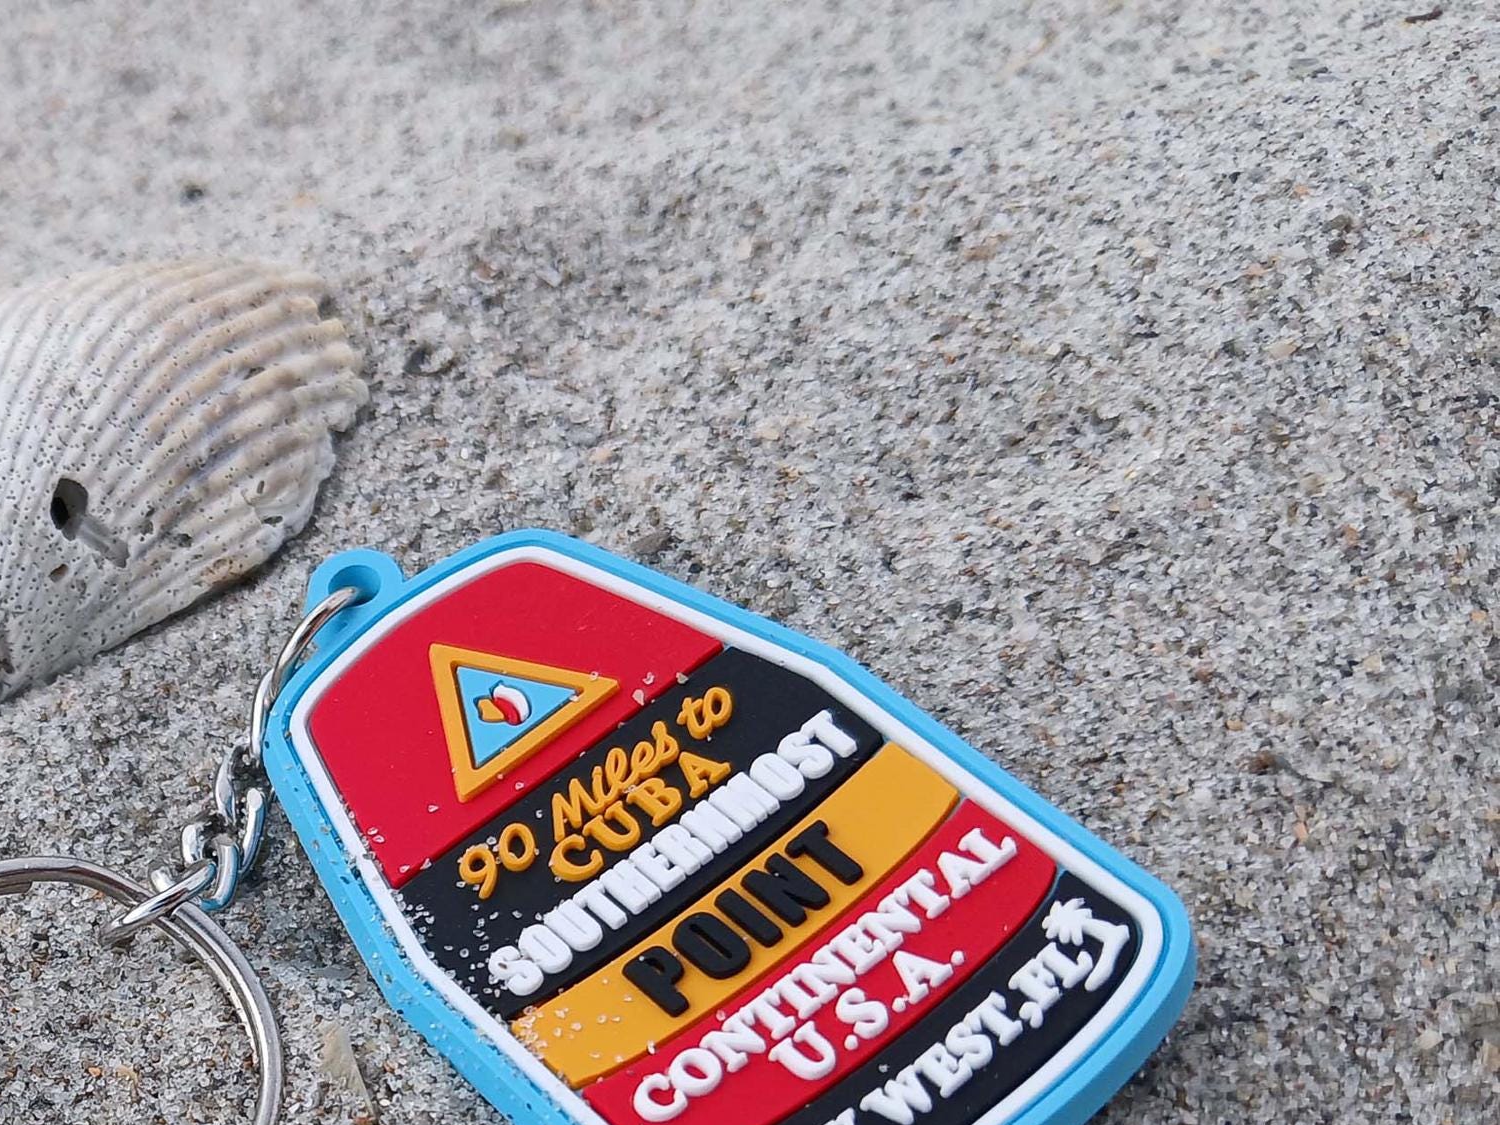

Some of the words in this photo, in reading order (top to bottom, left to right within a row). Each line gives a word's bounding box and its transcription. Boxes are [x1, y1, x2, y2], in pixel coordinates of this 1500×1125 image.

[459, 822, 536, 899] 90
[552, 721, 680, 842] Miles
[676, 686, 733, 739] to
[488, 708, 859, 996] SOUTHERNMOST
[550, 751, 732, 882] CUBA
[622, 819, 864, 1018] POINT
[633, 827, 1018, 1122] CONTINENTAL
[769, 950, 965, 1080] U.S.A.
